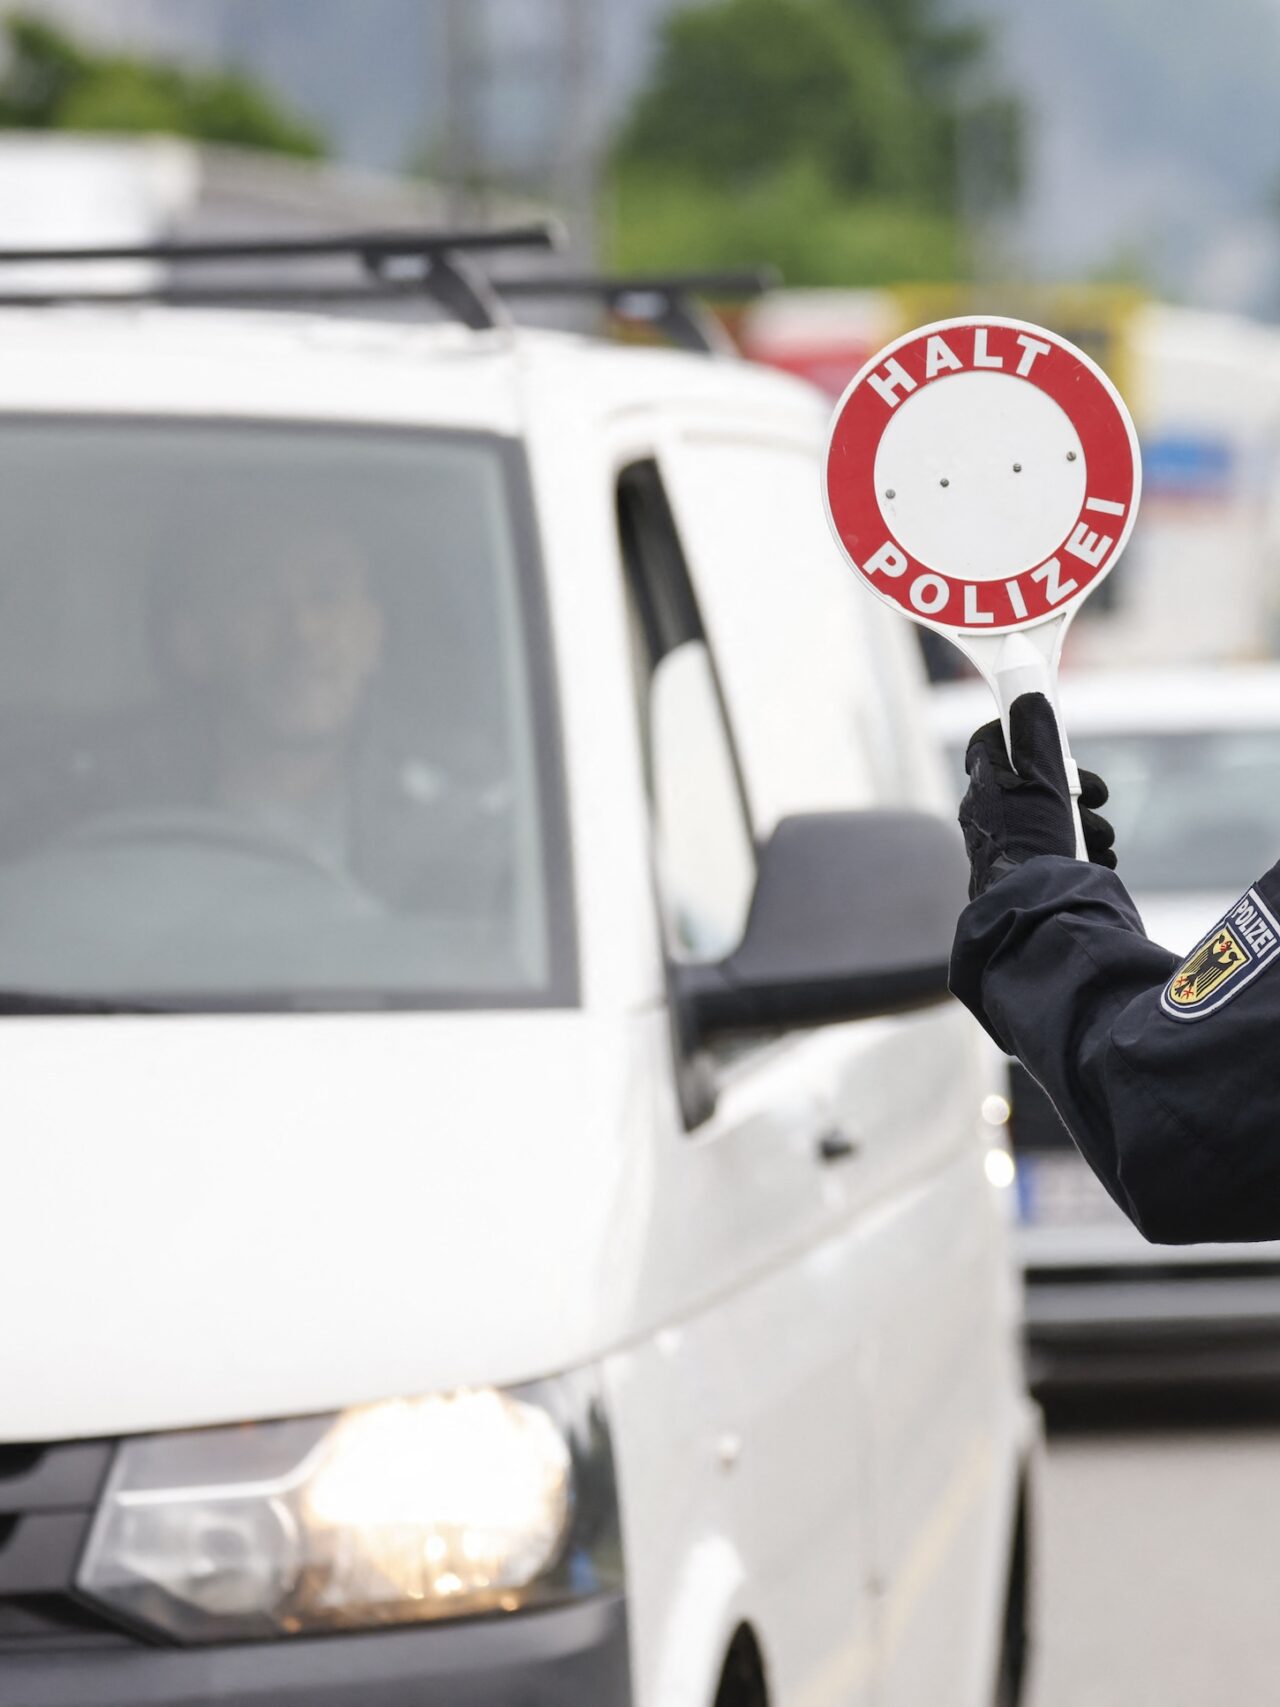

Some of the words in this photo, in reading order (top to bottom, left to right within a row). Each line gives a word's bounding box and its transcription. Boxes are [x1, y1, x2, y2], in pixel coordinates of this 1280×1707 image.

[866, 328, 1052, 408] HALT
[862, 496, 1126, 624] POLIZEI
[1231, 898, 1278, 959] POLIZEI
